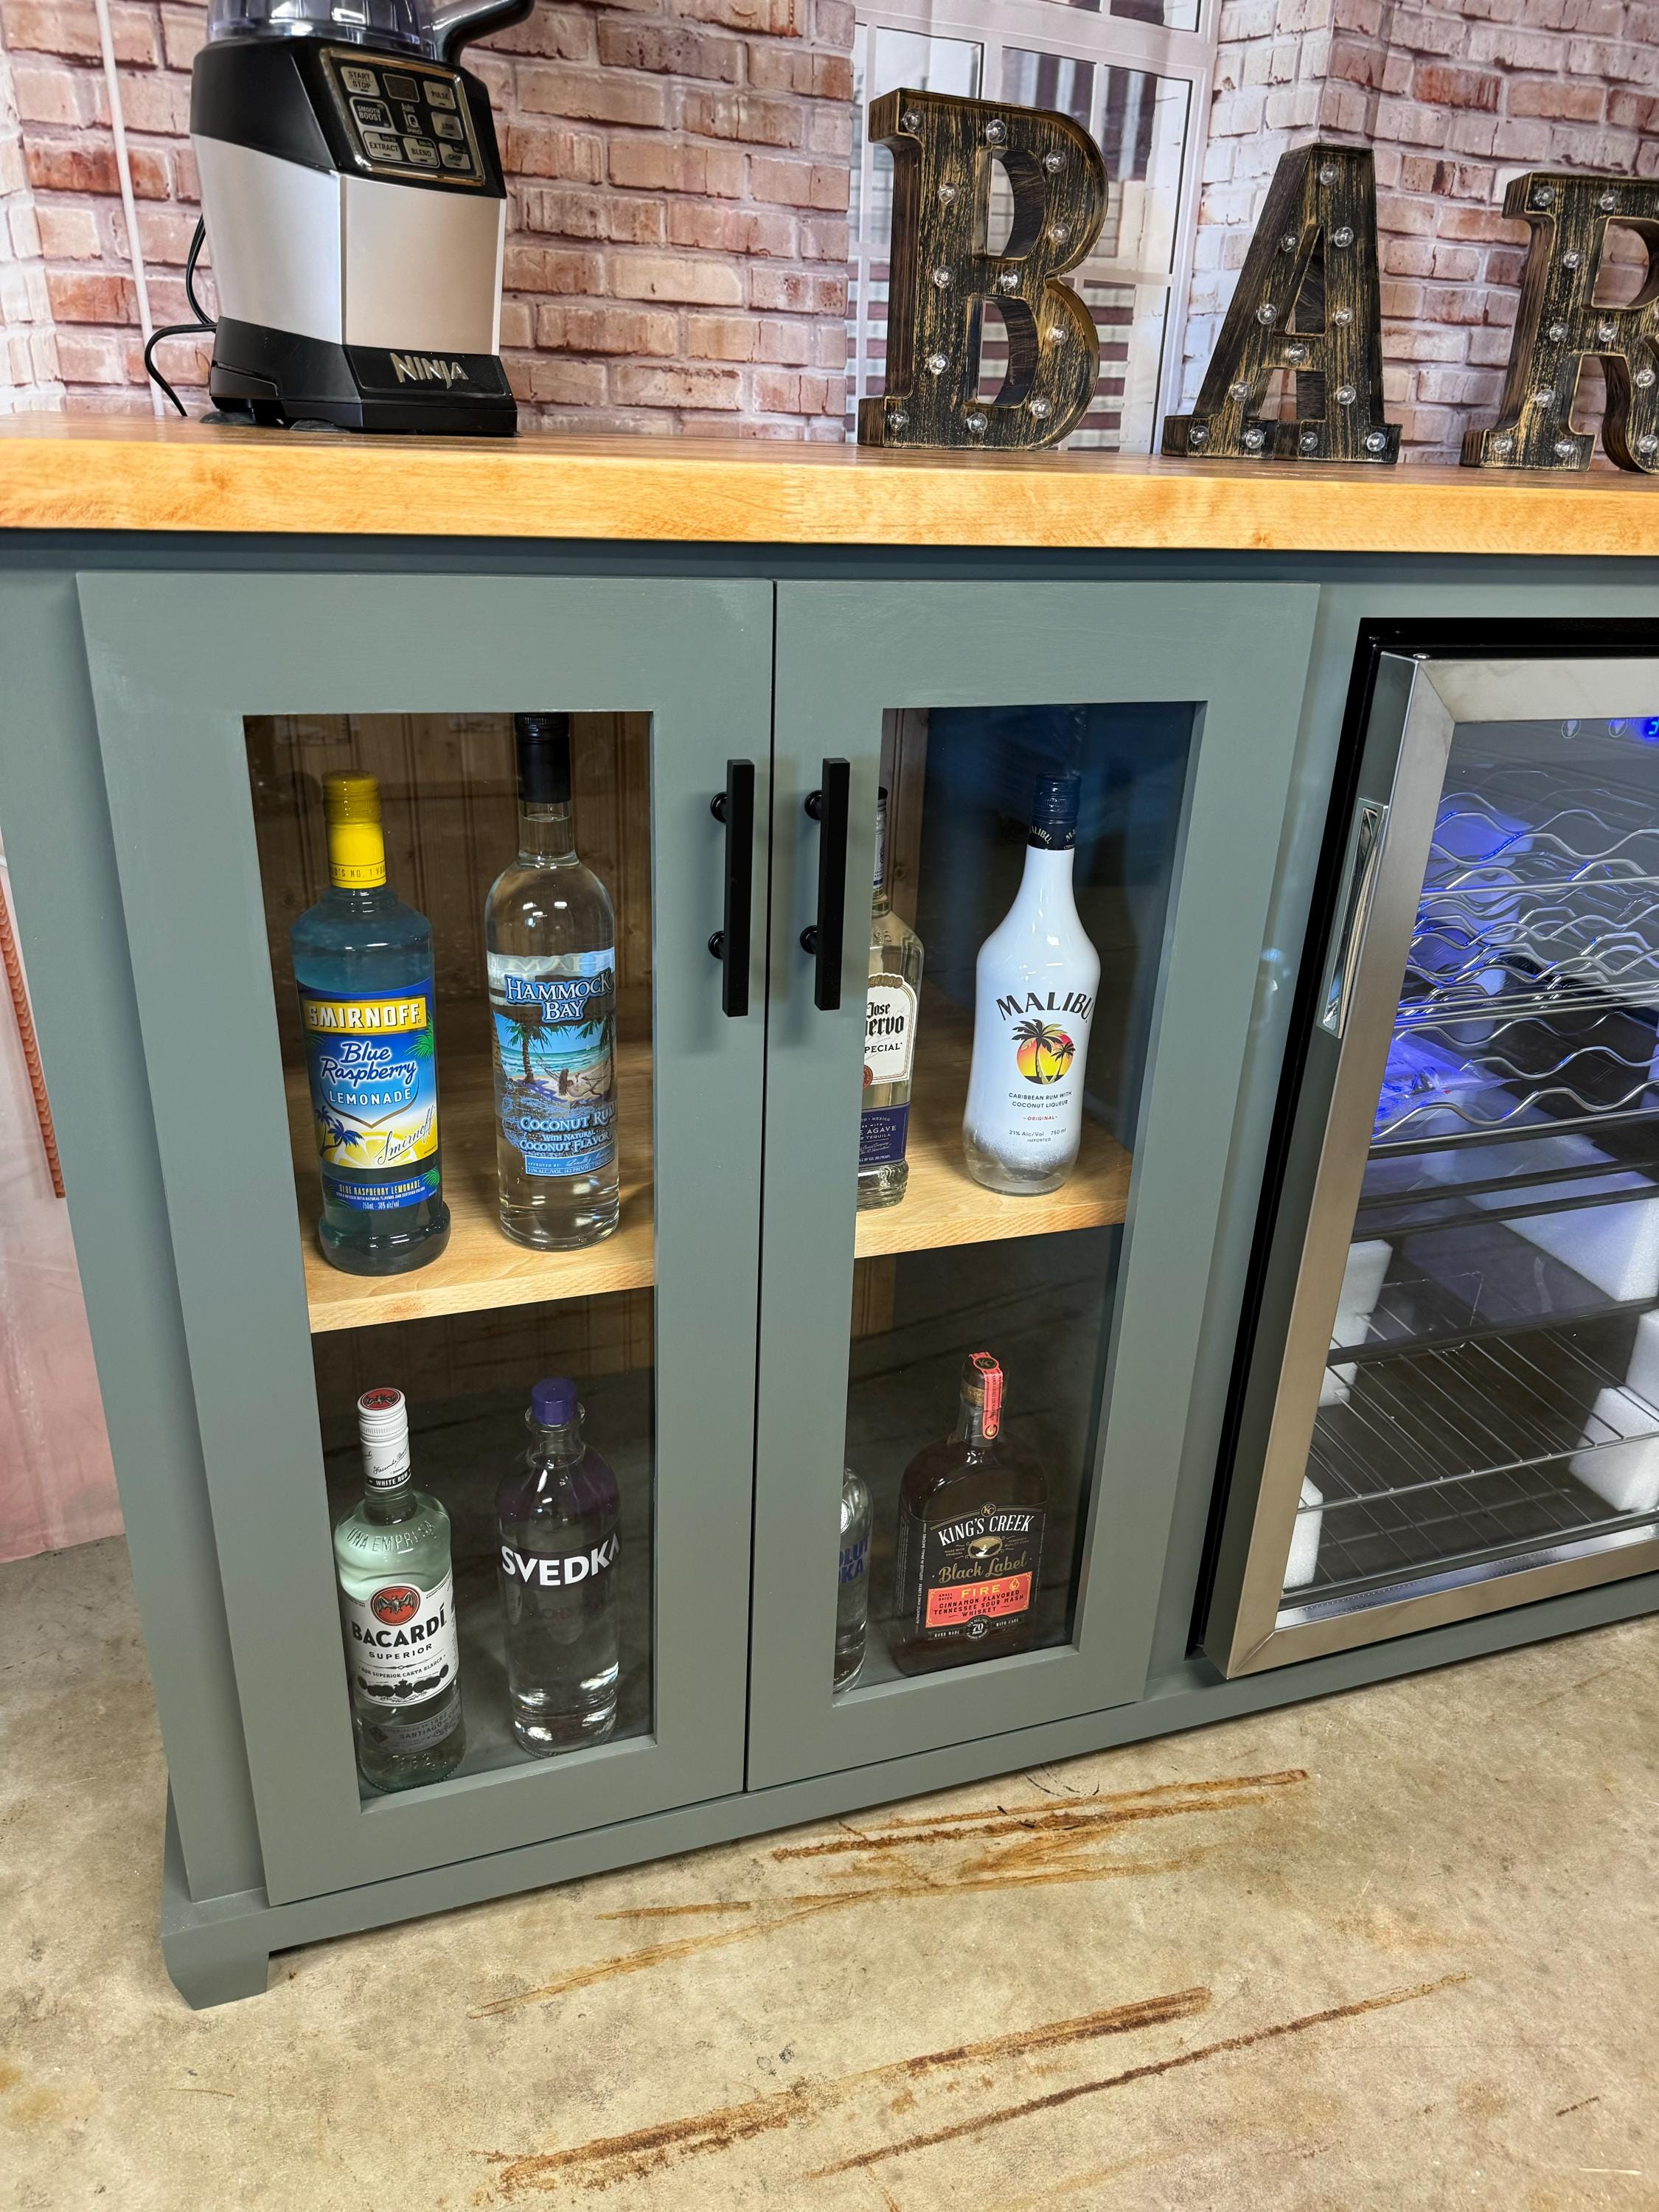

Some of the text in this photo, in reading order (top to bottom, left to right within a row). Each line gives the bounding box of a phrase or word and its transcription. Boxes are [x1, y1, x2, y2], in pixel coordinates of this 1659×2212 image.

[348, 71, 370, 80] START
[352, 80, 371, 88] STOP
[357, 105, 380, 114] SMOOTH
[358, 111, 381, 122] BOOST
[369, 142, 399, 152] EXTRACT
[411, 147, 432, 157] BLEND
[389, 352, 469, 389] NINJA
[350, 869, 365, 878] NO.
[505, 970, 613, 1001] HAMMOCK
[545, 999, 585, 1020] BAY
[866, 1001, 891, 1019] Jose
[995, 992, 1094, 1021] MALIBU
[308, 1003, 420, 1029] SMIRNOFF
[866, 1015, 905, 1037] ervo
[340, 1042, 391, 1064] Blue
[864, 1043, 902, 1054] PECIAL
[321, 1057, 417, 1088] Raspberry
[329, 1088, 411, 1105] LEMONADE
[1046, 1100, 1068, 1108] LIQUEUR
[520, 1116, 590, 1132] COCONUT
[866, 1125, 897, 1135] AGAVE
[374, 1105, 434, 1165] Smirnoff
[519, 1132, 612, 1152] COCONUT FLAVOR
[564, 1130, 596, 1141] NATURAL
[339, 1183, 352, 1194] BLUE
[354, 1187, 389, 1196] RASPBERRY
[391, 1180, 420, 1194] LEMONADE
[375, 1478, 397, 1486] WHITE
[984, 1505, 995, 1515] KC
[347, 1527, 369, 1550] UNA
[938, 1514, 1035, 1546] KING'S CREEK
[501, 1531, 620, 1586] SVEDKA
[939, 1551, 1027, 1584] Black Label
[939, 1590, 1020, 1608] CINNAMON FLAVORED
[961, 1584, 1001, 1599] FIRE
[934, 1604, 977, 1615] TENNESSEE
[1004, 1594, 1024, 1604] MASH
[962, 1607, 997, 1617] WHISKEY
[352, 1602, 444, 1648] BACARDÍ
[973, 1623, 984, 1632] 70
[369, 1643, 432, 1660] SUPERIOR
[403, 1669, 422, 1677] CARTA
